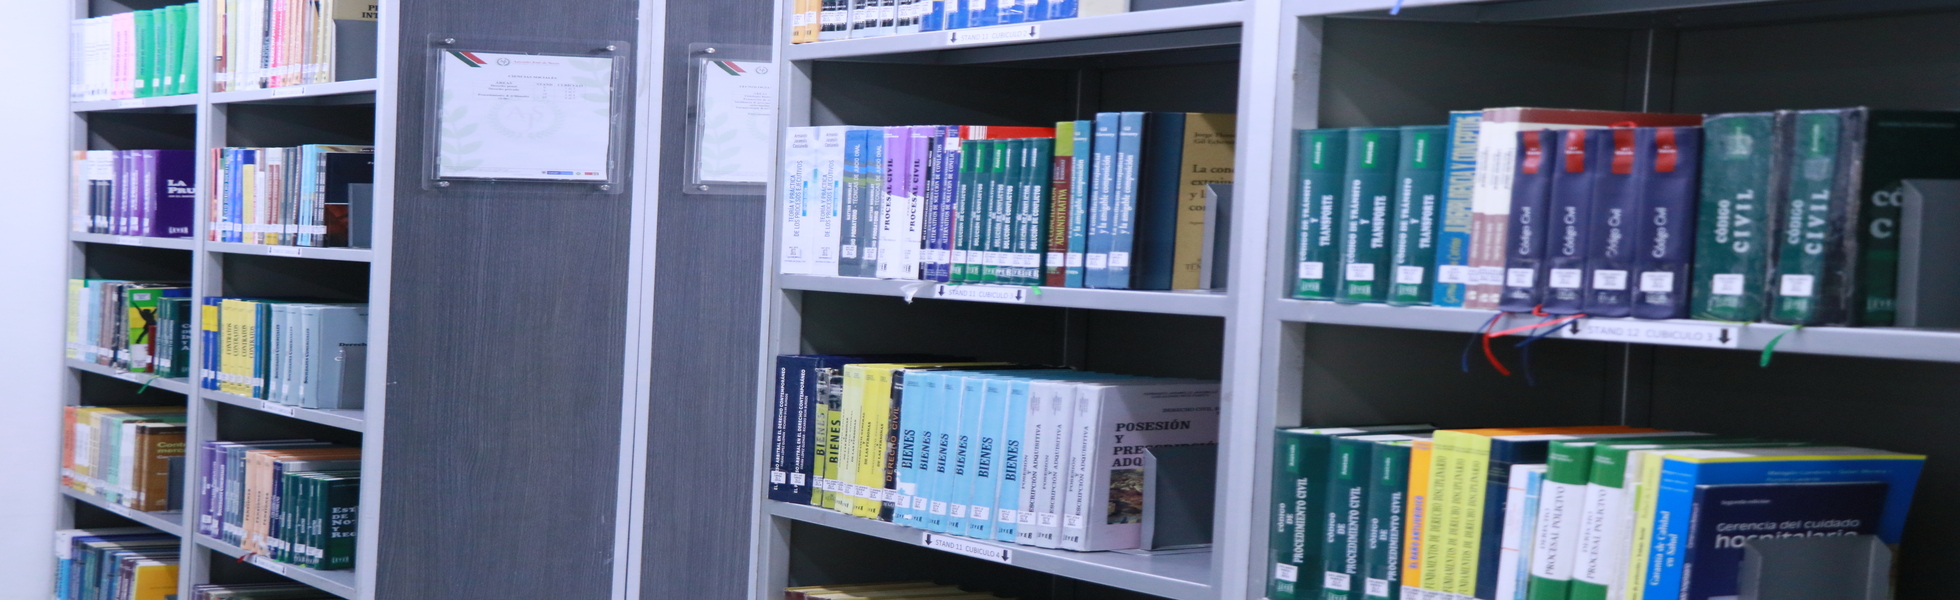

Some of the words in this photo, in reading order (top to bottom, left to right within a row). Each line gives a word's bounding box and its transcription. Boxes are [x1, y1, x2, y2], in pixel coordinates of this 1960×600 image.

[1451, 116, 1480, 160] CONCEPTOS
[1192, 164, 1207, 174] La
[884, 184, 892, 230] PROCESAL
[910, 185, 918, 232] PROCESAL
[1056, 188, 1068, 246] ADMINISTRATIVA
[1100, 194, 1111, 222] amigable
[1318, 194, 1333, 246] TRANSPORTE
[1371, 195, 1386, 248] TRANSPORTE
[1418, 194, 1434, 248] TRANSPORTE
[1521, 206, 1530, 224] Civil
[1564, 206, 1576, 224] Civil
[1608, 208, 1622, 226] Civil
[1654, 206, 1667, 226] Civil
[1714, 199, 1731, 243] CÓDIGO
[1732, 188, 1754, 253] CIVIL
[1786, 199, 1804, 244] CÓDIGO
[1805, 189, 1830, 254] CIVIL
[1302, 220, 1310, 230] DE
[1349, 220, 1358, 232] DE
[1399, 220, 1408, 230] DE
[1519, 226, 1531, 254] Código
[1562, 225, 1577, 255] Código
[1652, 226, 1668, 258] Código
[948, 289, 968, 297] STAND
[968, 290, 976, 298] 11
[978, 290, 1009, 299] CUBICULO
[1587, 326, 1623, 336] STAND
[1626, 328, 1639, 336] 12
[1645, 329, 1703, 340] CUBICULO
[778, 367, 786, 408] CONTEMPORÁNEO
[798, 369, 806, 410] CONTEMPORÁNEO
[816, 412, 825, 455] BIENES
[828, 420, 840, 463] BIENES
[1115, 434, 1124, 444] Y
[1116, 419, 1191, 432] POSESIÓN
[886, 436, 897, 481] DERECHO
[892, 406, 900, 430] CIVIL
[902, 430, 915, 469] BIENES
[920, 431, 931, 470] BIENES
[936, 434, 949, 473] BIENES
[956, 436, 968, 476] BIENES
[978, 437, 993, 478] BIENES
[1032, 424, 1041, 469] ADQUISITIVA
[1005, 440, 1019, 481] BIENES
[1076, 474, 1084, 516] ESCRIPCIÓN
[1080, 426, 1088, 472] ADQUISITIVA
[1028, 470, 1038, 512] ESCRIPCIÓN
[1296, 478, 1308, 498] CIVIL
[1433, 456, 1447, 502] DISCIPLINARIO
[1452, 458, 1465, 504] DISCIPLINARIO
[1350, 486, 1362, 508] CIVIL
[1390, 492, 1402, 514] CIVIL
[1286, 514, 1294, 524] DE
[1292, 500, 1306, 563] PROCEDIMIENTO
[1336, 523, 1346, 534] DE
[1430, 502, 1443, 532] DERECHO
[1448, 506, 1461, 535] DERECHO
[1545, 532, 1559, 576] PROCESAL
[1552, 486, 1566, 528] POLICIVO
[1656, 510, 1670, 541] Calidad
[1716, 522, 1776, 532] Gerencia
[1779, 520, 1802, 530] del
[1804, 518, 1860, 529] cuidado
[936, 539, 954, 548] STAND
[965, 545, 994, 557] CUBICULO
[1345, 510, 1360, 574] PROCEDIMIENTO
[1379, 530, 1388, 540] DE
[1387, 515, 1400, 581] PROCEDIMIENTO
[1430, 534, 1439, 542] DE
[1448, 538, 1457, 546] DE
[1586, 536, 1602, 579] PROCESAL
[1594, 490, 1606, 532] POLICIVO
[1656, 542, 1665, 552] de
[1666, 534, 1678, 556] Salud
[1409, 561, 1418, 569] EL
[1410, 542, 1420, 560] DAÑO
[1424, 544, 1438, 589] FUNDAMENTOS
[1666, 558, 1674, 568] en
